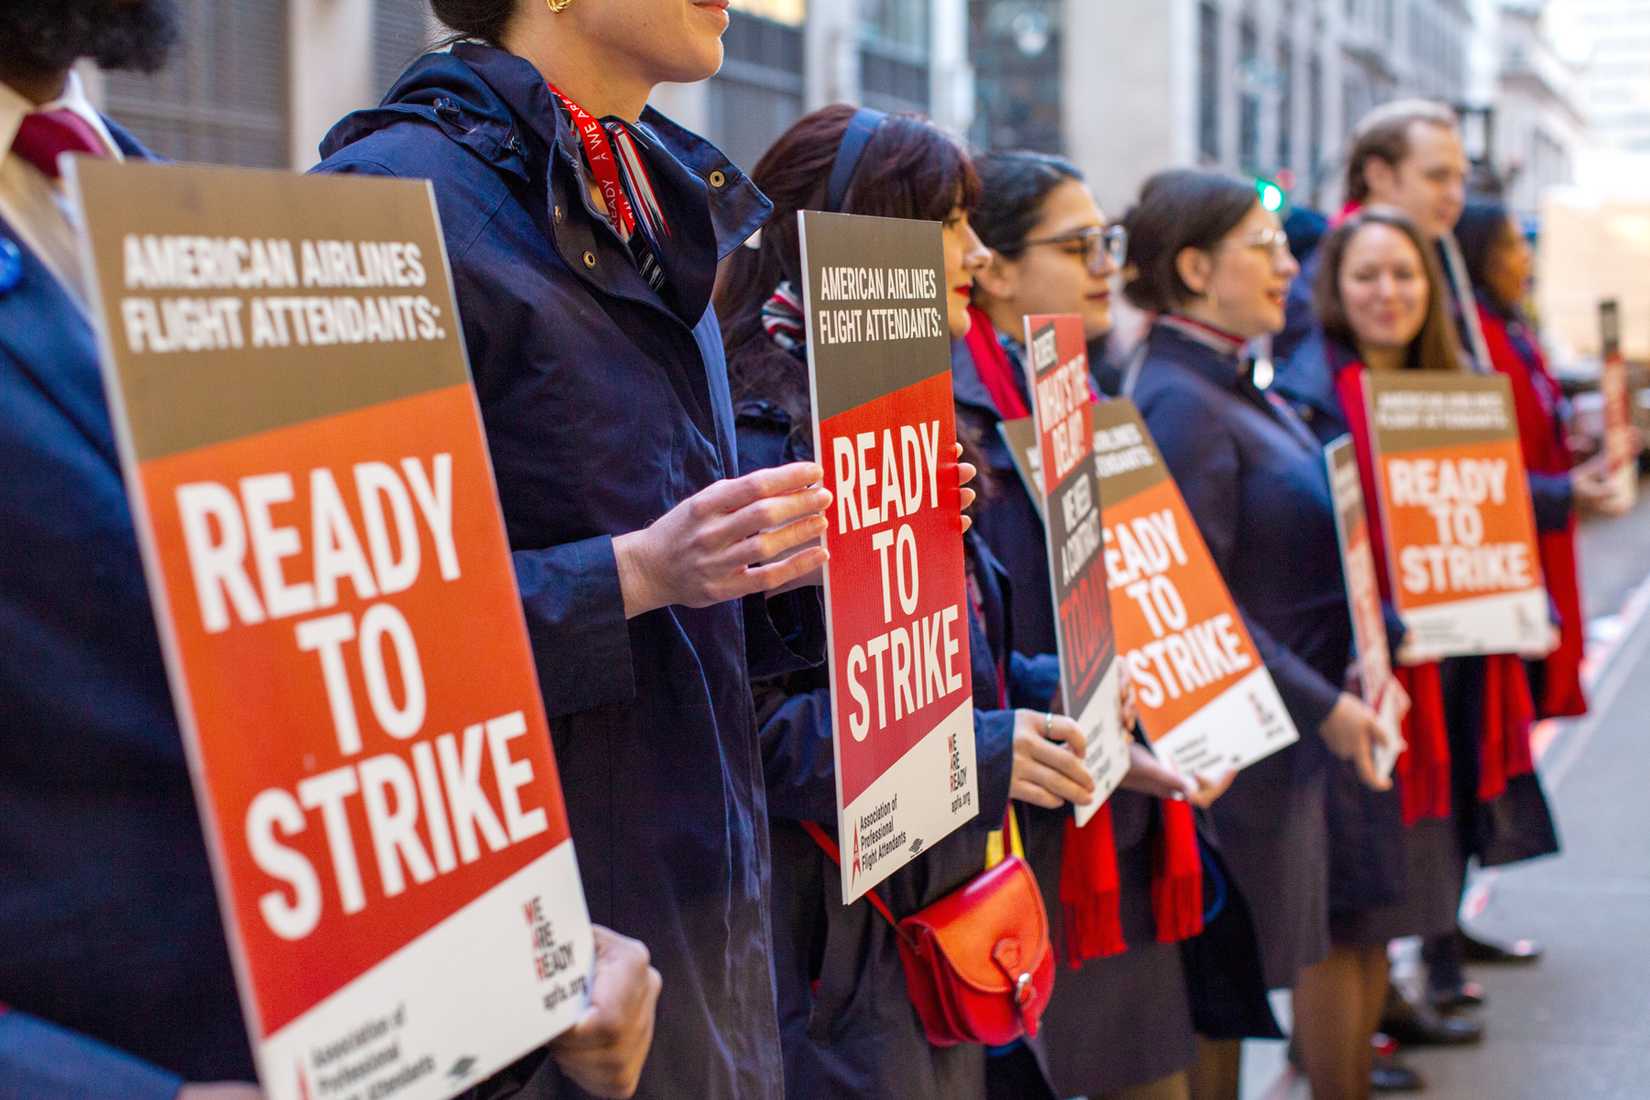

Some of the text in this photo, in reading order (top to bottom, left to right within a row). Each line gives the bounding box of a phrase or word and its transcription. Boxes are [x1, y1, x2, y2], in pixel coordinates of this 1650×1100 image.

[584, 121, 604, 150] WE
[123, 233, 426, 289] AMERICAN AIRLINES
[821, 267, 936, 301] AMERICAN AIRLINES
[123, 295, 446, 354] FLIGHT ATTENDANTS:
[819, 307, 942, 344] FLIGHT ATTENDANTS:
[832, 420, 940, 535] READY
[1387, 457, 1508, 507] READY
[175, 453, 461, 635] READY
[1427, 497, 1483, 548] TO
[872, 523, 919, 624] TO
[1102, 508, 1188, 591] EADY
[1400, 542, 1533, 594] STRIKE
[1126, 574, 1188, 638] TO
[295, 602, 427, 756] TO
[847, 604, 962, 742] STRIKE
[1126, 612, 1252, 710] STRIKE
[947, 732, 957, 754] WE
[949, 751, 960, 772] ARE
[949, 766, 968, 792] READY
[245, 710, 549, 941] STRIKE
[860, 801, 891, 831] Association
[861, 815, 894, 852] Professional
[862, 831, 906, 871] Flight Attendants
[534, 942, 574, 983] READY
